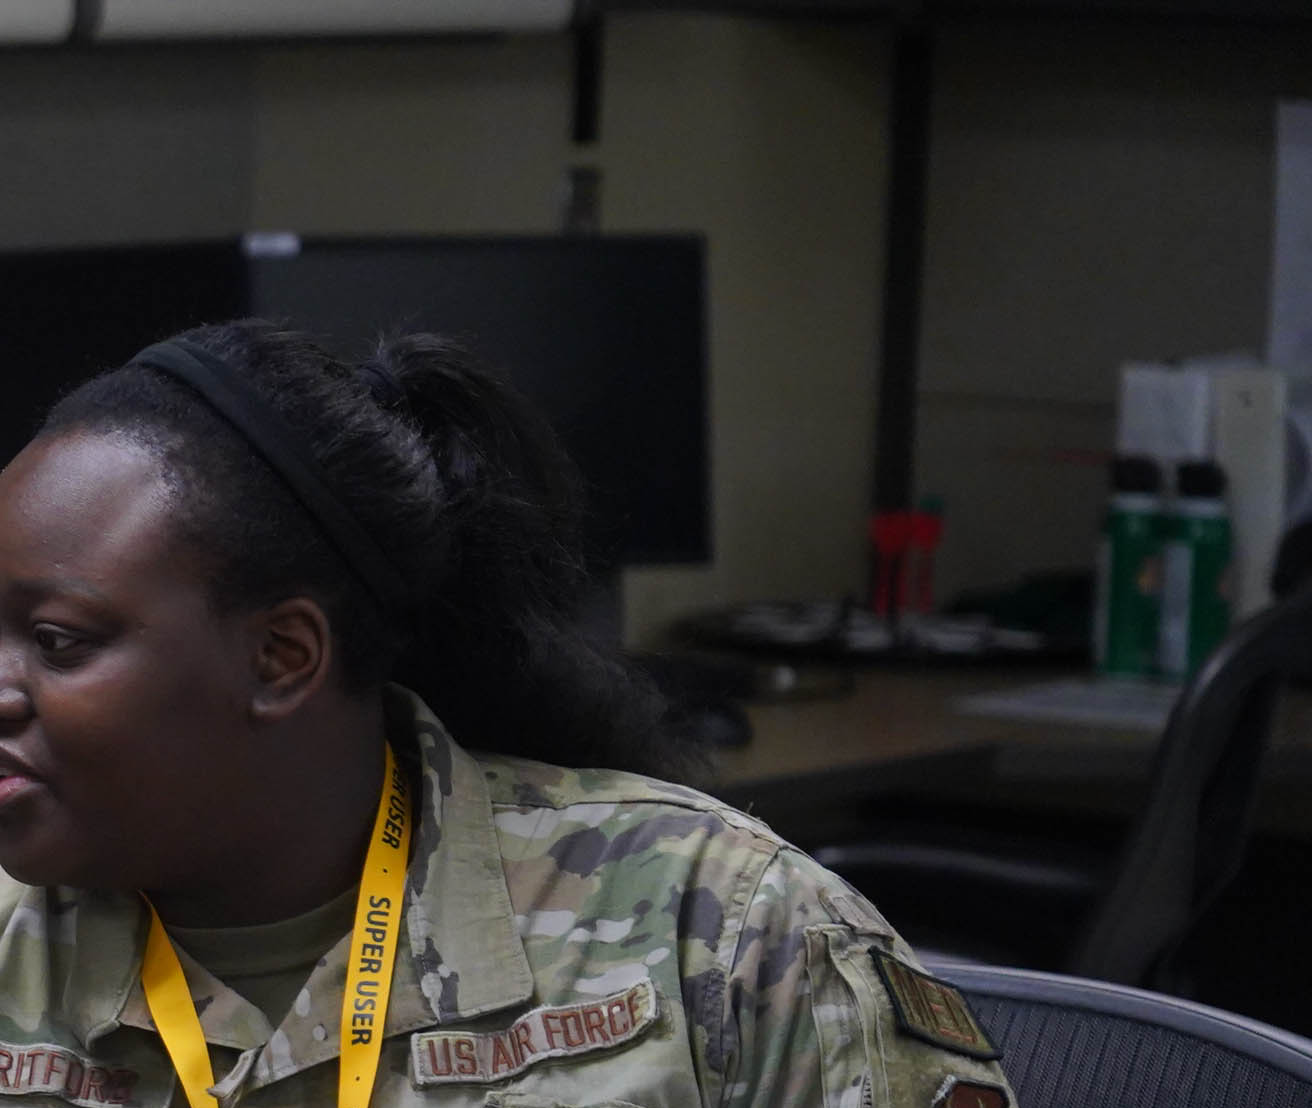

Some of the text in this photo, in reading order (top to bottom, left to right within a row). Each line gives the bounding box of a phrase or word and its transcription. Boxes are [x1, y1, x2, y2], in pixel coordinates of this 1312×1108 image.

[381, 794, 408, 850] USER
[351, 895, 391, 1045] SUPER USER
[492, 1022, 537, 1075] AIR
[541, 991, 641, 1050] FORCE
